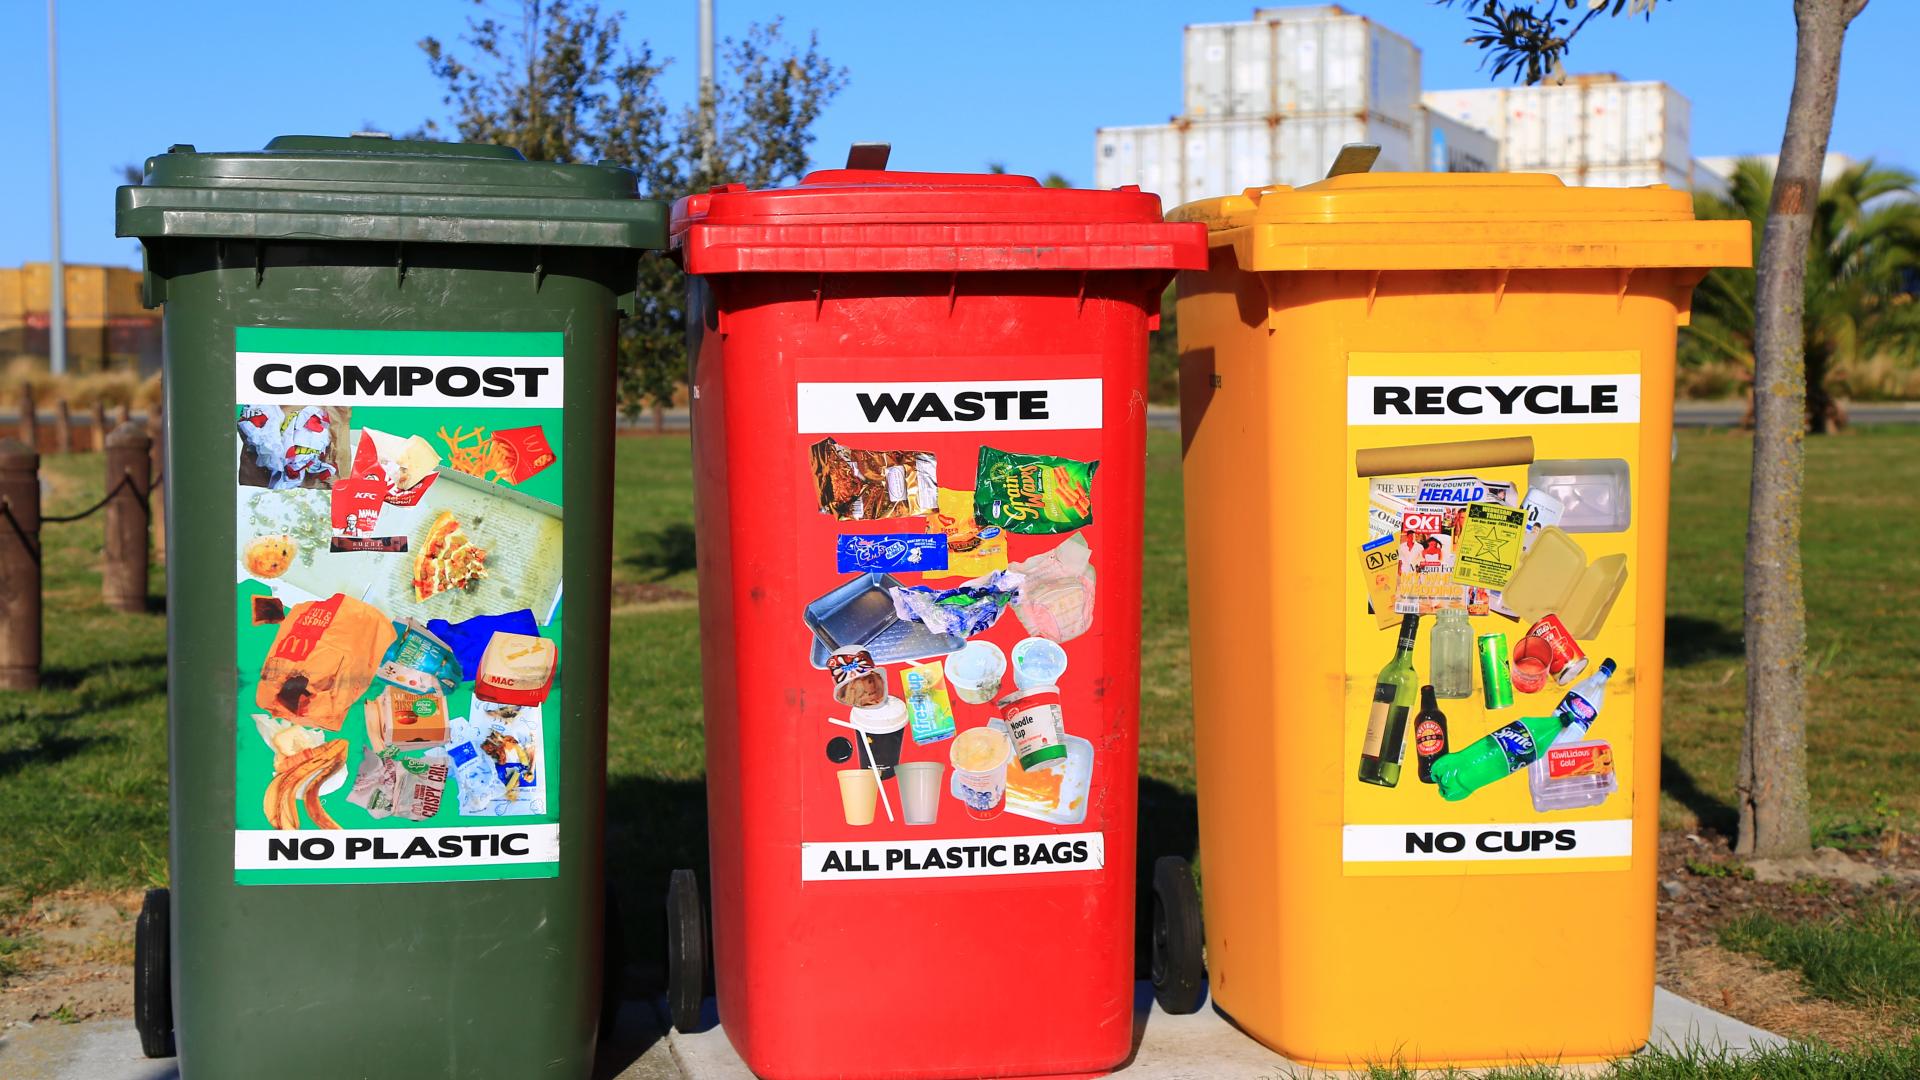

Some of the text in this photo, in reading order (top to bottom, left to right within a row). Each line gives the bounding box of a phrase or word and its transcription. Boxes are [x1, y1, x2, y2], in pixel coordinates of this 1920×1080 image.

[253, 363, 549, 397] COMPOST
[856, 390, 1049, 423] WASTE
[1374, 385, 1618, 415] RECYCLE
[354, 492, 377, 500] KFC
[1376, 483, 1394, 493] THE
[1418, 487, 1484, 502] HERALD
[1003, 475, 1040, 521] Grain
[1405, 514, 1440, 530] OK!
[491, 676, 515, 686] MAC
[1010, 715, 1034, 731] Noodle
[1014, 729, 1026, 740] Cup
[1494, 727, 1533, 749] Sprite
[1551, 749, 1590, 760] KiwiLicious
[1560, 759, 1576, 767] Gold
[268, 832, 529, 861] NO PLASTIC
[1405, 829, 1576, 854] NO CUPS
[821, 840, 1088, 872] ALL PLASTIC BAGS
